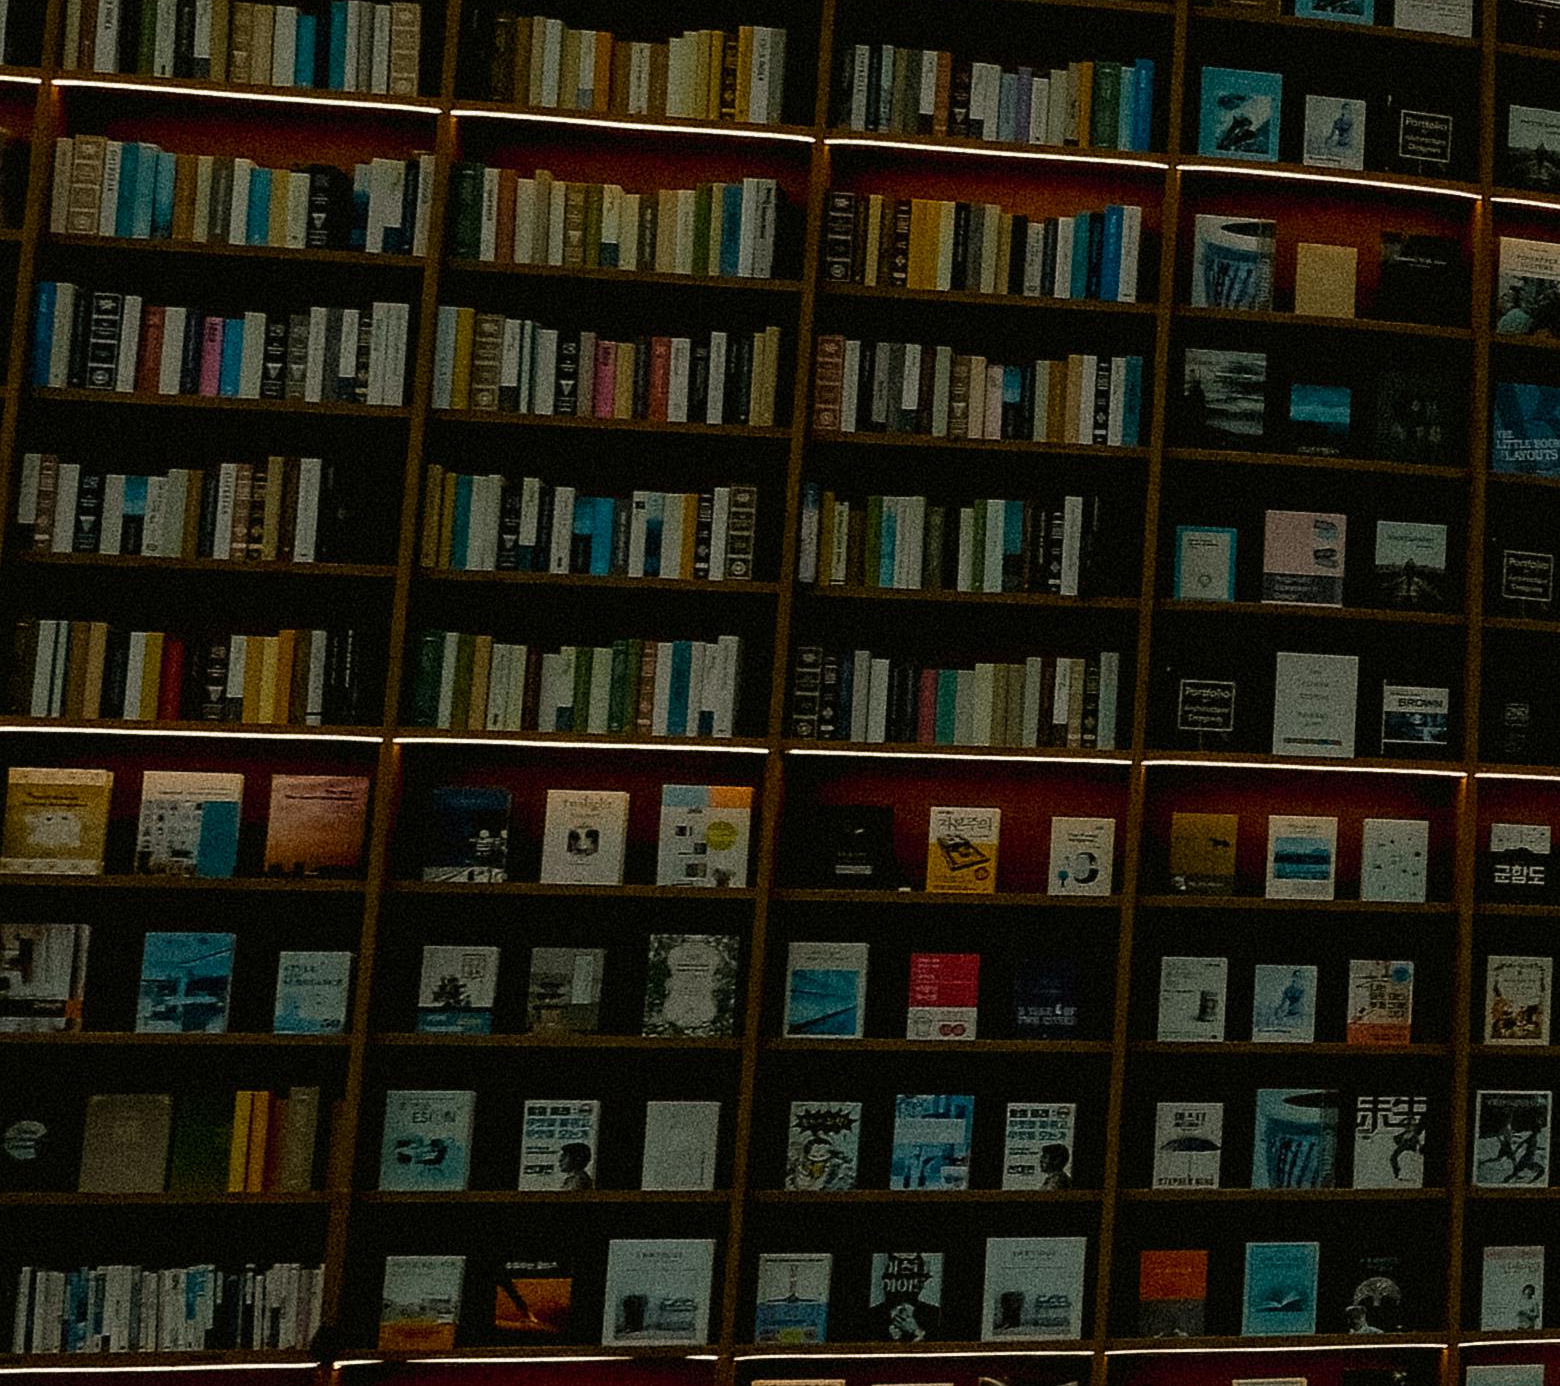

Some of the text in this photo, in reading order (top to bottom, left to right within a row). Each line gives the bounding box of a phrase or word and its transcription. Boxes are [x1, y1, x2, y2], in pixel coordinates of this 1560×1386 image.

[1496, 439, 1533, 449] LITTLE
[1505, 449, 1558, 461] LAYOUTS
[1494, 864, 1545, 886] 군함도
